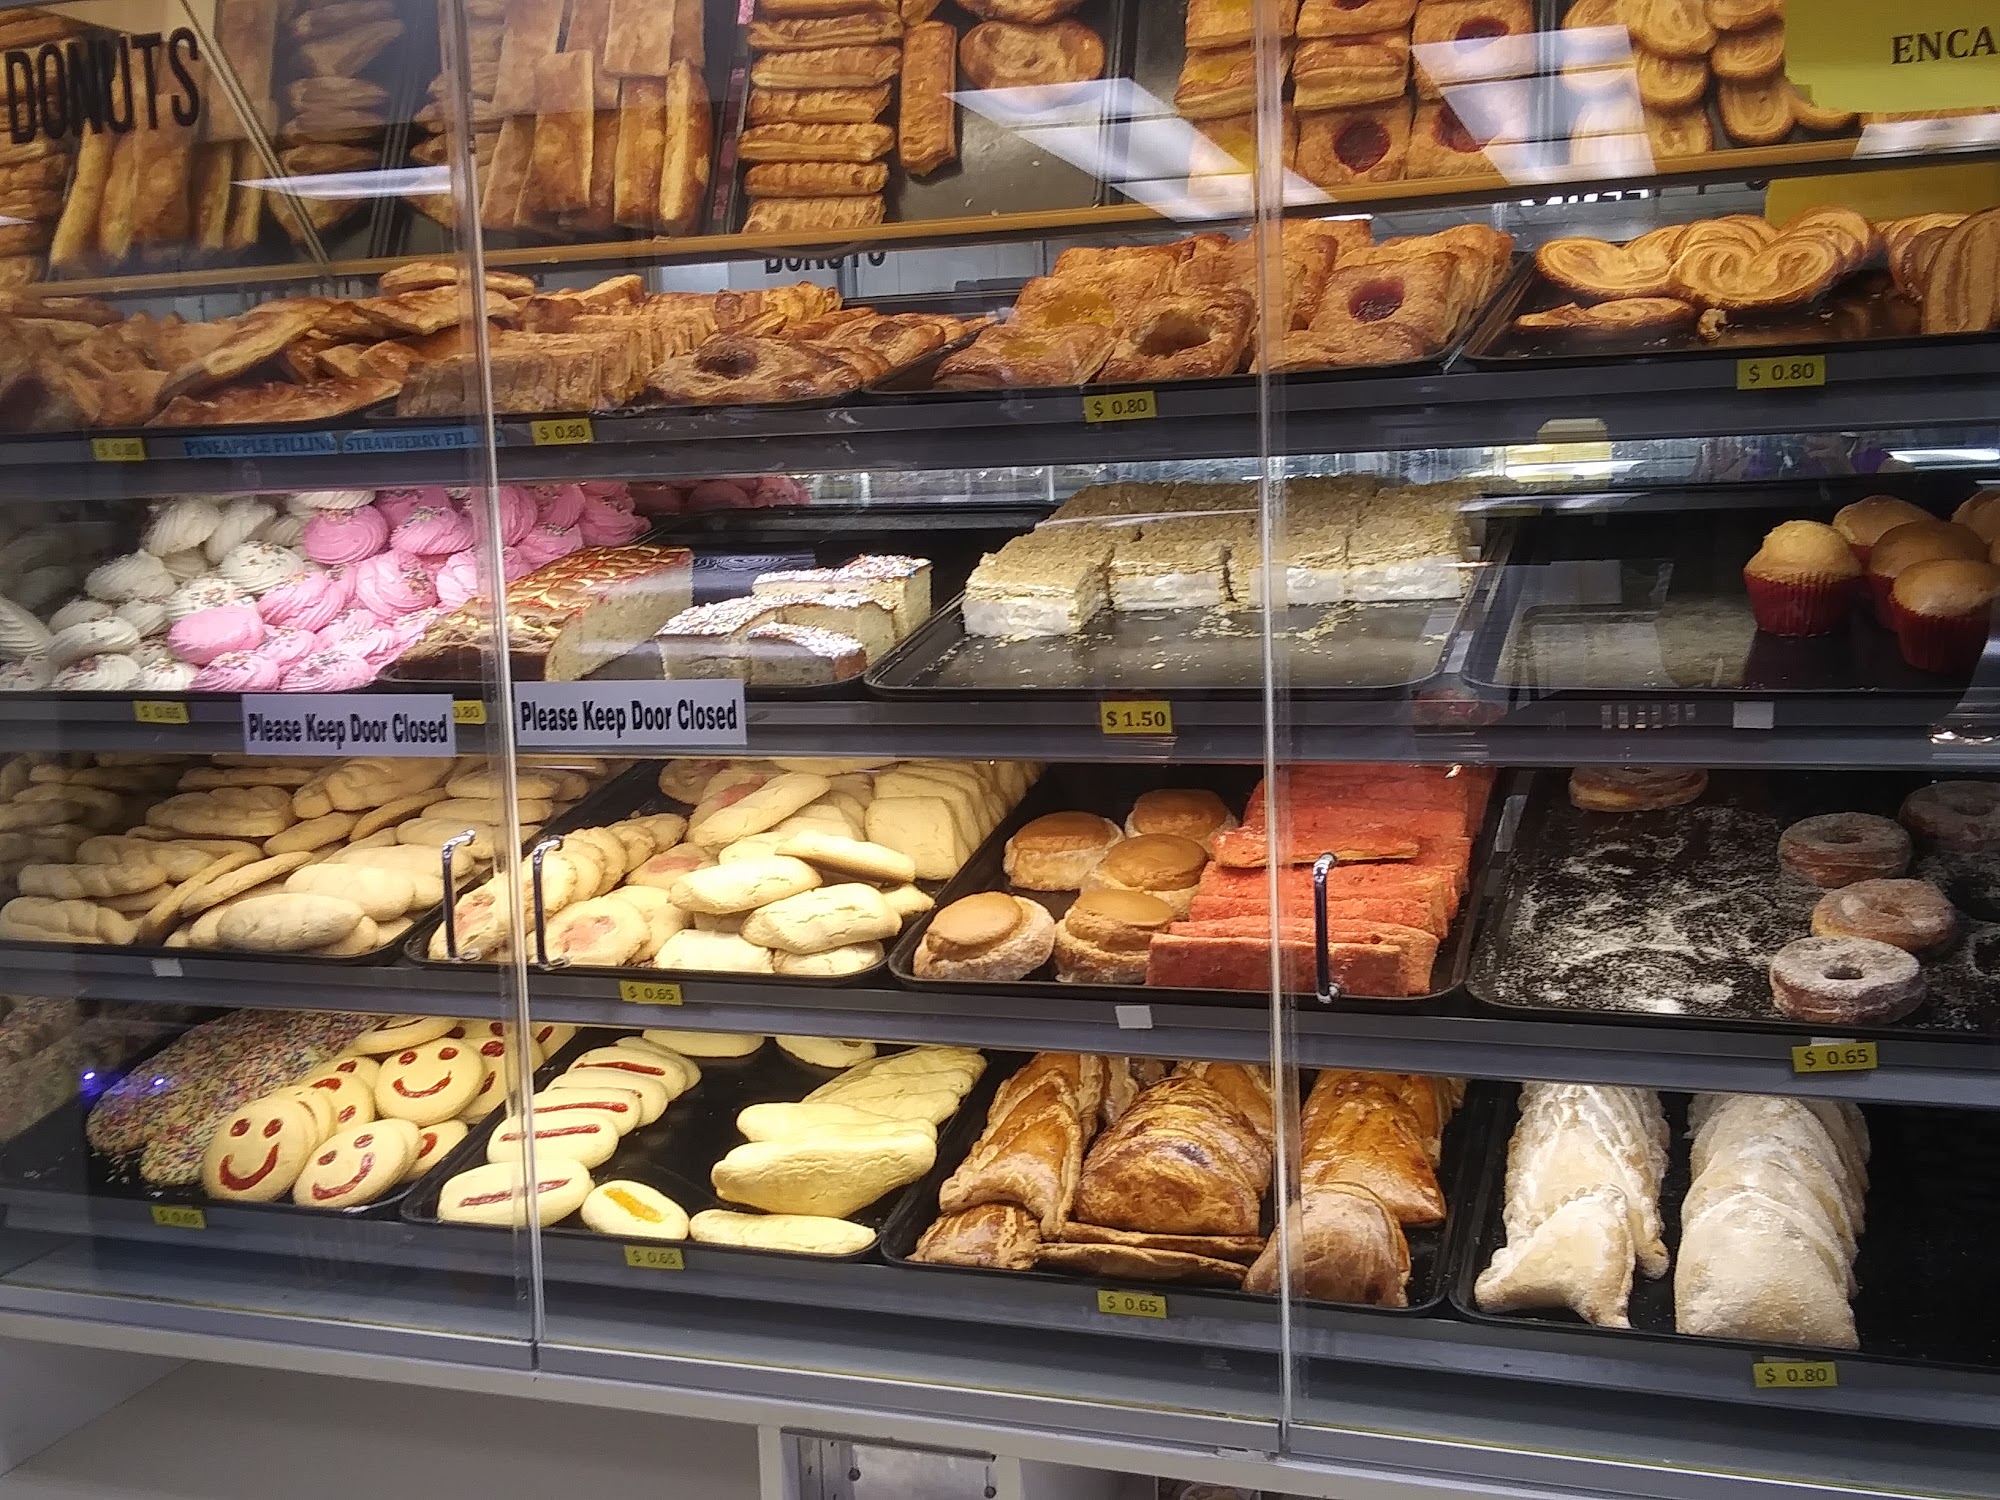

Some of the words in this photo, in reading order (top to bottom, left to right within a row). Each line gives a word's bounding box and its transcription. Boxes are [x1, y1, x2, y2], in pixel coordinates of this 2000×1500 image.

[5, 27, 199, 144] DONUTS
[1749, 364, 1760, 384] $
[1772, 362, 1815, 381] 0.80
[1093, 400, 1104, 418] $
[1112, 398, 1147, 415] 0.80
[344, 432, 440, 451] STRAWBERRY
[539, 426, 549, 441] $
[555, 424, 586, 440] 0.80
[184, 438, 272, 457] PINEAPPLE
[274, 435, 336, 453] FILLING
[520, 701, 578, 731] Please
[582, 700, 626, 738] Keep
[631, 700, 672, 730] Door
[677, 699, 738, 730] Closed
[1106, 711, 1118, 728] $
[1123, 710, 1166, 727] 1.50
[248, 713, 301, 743] Please
[305, 713, 346, 750] Keep
[350, 713, 388, 743] Door
[392, 713, 448, 743] Closed
[628, 986, 637, 999] $
[643, 987, 675, 1000] 0.65
[1804, 1050, 1816, 1067] $
[1826, 1049, 1869, 1065] 0.65
[1106, 1296, 1116, 1310] $
[1124, 1298, 1157, 1312] 0.65
[1764, 1368, 1776, 1383] $
[1786, 1368, 1827, 1382] 0.80
